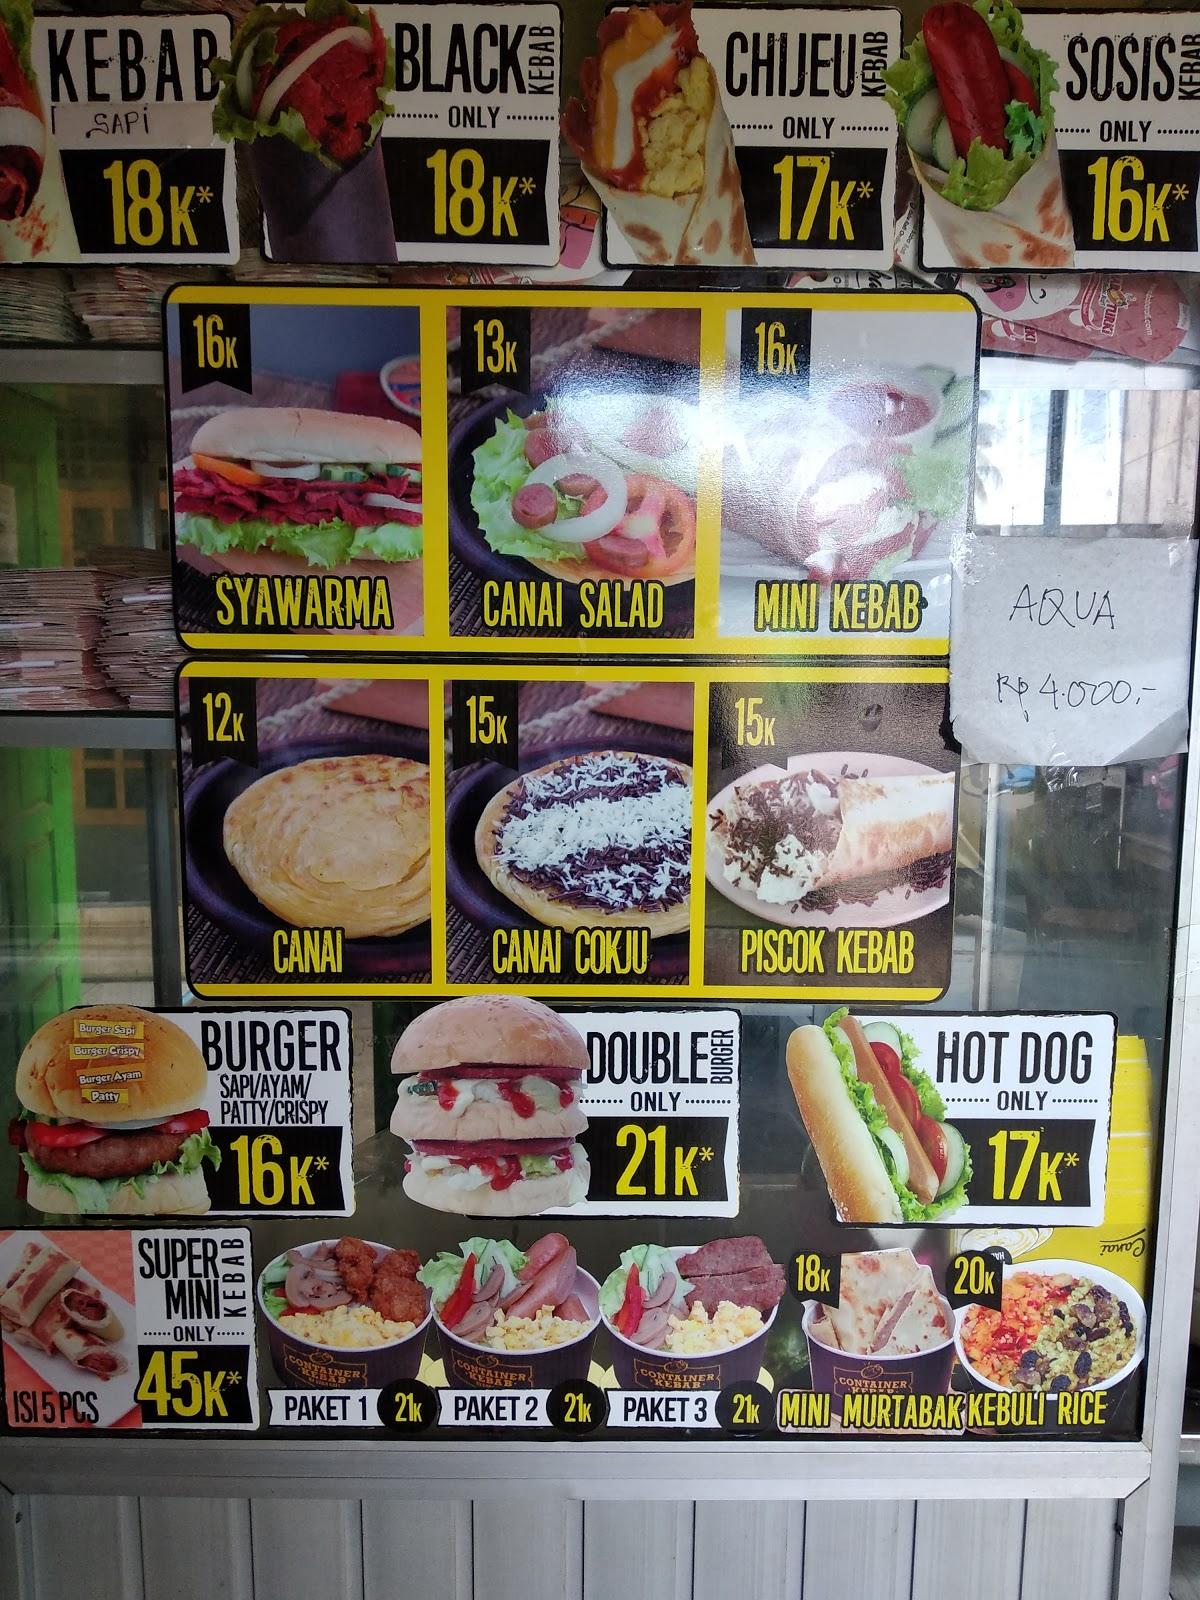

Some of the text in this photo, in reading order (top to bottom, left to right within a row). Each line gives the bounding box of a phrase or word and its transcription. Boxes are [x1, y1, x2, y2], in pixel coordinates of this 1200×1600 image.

[48, 28, 220, 102] KEBAB
[395, 22, 527, 94] BLACK
[528, 25, 555, 95] KEBAB
[726, 31, 856, 97] CHIJEU
[861, 31, 888, 97] KEBAB
[1066, 35, 1176, 102] SOSIS
[1178, 33, 1200, 101] KEBAB
[448, 105, 500, 128] ONLY
[782, 117, 835, 139] ONLY
[1100, 120, 1152, 143] ONLY
[192, 313, 239, 369] 16K
[473, 319, 517, 374] 13K
[754, 321, 799, 375] 16K
[215, 575, 392, 627] SYAWARMA
[483, 580, 664, 628] CANAI SALAD
[756, 582, 920, 630] MINI KEBAB
[1009, 584, 1115, 629] AQUA
[202, 692, 245, 742] 12K
[466, 695, 508, 744] 15K
[735, 697, 775, 746] 15K
[273, 929, 343, 974] CANAI
[492, 929, 648, 975] CANAI COKJU
[741, 929, 914, 974] PISCOK KEBAB
[79, 1023, 136, 1036] Burger Sapi
[201, 1020, 341, 1073] BURGER
[74, 1046, 140, 1056] Burger Crispy
[587, 1031, 708, 1085] DOUBLE
[710, 1029, 734, 1085] BURGER
[936, 1031, 1094, 1085] HOT DOG
[79, 1070, 142, 1085] Burger Ayam
[91, 1091, 120, 1102] Patty
[219, 1072, 312, 1100] SAPI/AYAM/
[221, 1099, 329, 1126] PATTY/CRISPY
[630, 1091, 682, 1112] ONLY
[997, 1090, 1048, 1111] ONLY
[138, 1237, 220, 1279] SUPER
[1100, 1238, 1146, 1258] Canai
[221, 1238, 247, 1318] KEBAB
[795, 1253, 830, 1292] 18K
[954, 1255, 995, 1296] 20K
[165, 1279, 220, 1320] MINI
[173, 1326, 215, 1342] ONLY
[288, 1355, 361, 1378] CONTAINER
[301, 1367, 347, 1384] KEBAB
[456, 1359, 526, 1381] CONTAINER
[468, 1371, 513, 1387] KEBAB
[640, 1368, 715, 1382] CONTAINER
[653, 1378, 702, 1389] KEBAB
[838, 1377, 908, 1389] CONTAINER
[13, 1390, 100, 1424] ISI 5 PCS
[284, 1396, 367, 1421] PAKET 1
[395, 1392, 422, 1422] 21K
[454, 1396, 538, 1421] PAKET 2
[564, 1393, 591, 1423] 21K
[624, 1397, 707, 1422] PAKET 3
[732, 1394, 760, 1423] 21K
[781, 1392, 965, 1429] MINI MURTABAK
[968, 1391, 1108, 1427] KEBULI RICE
